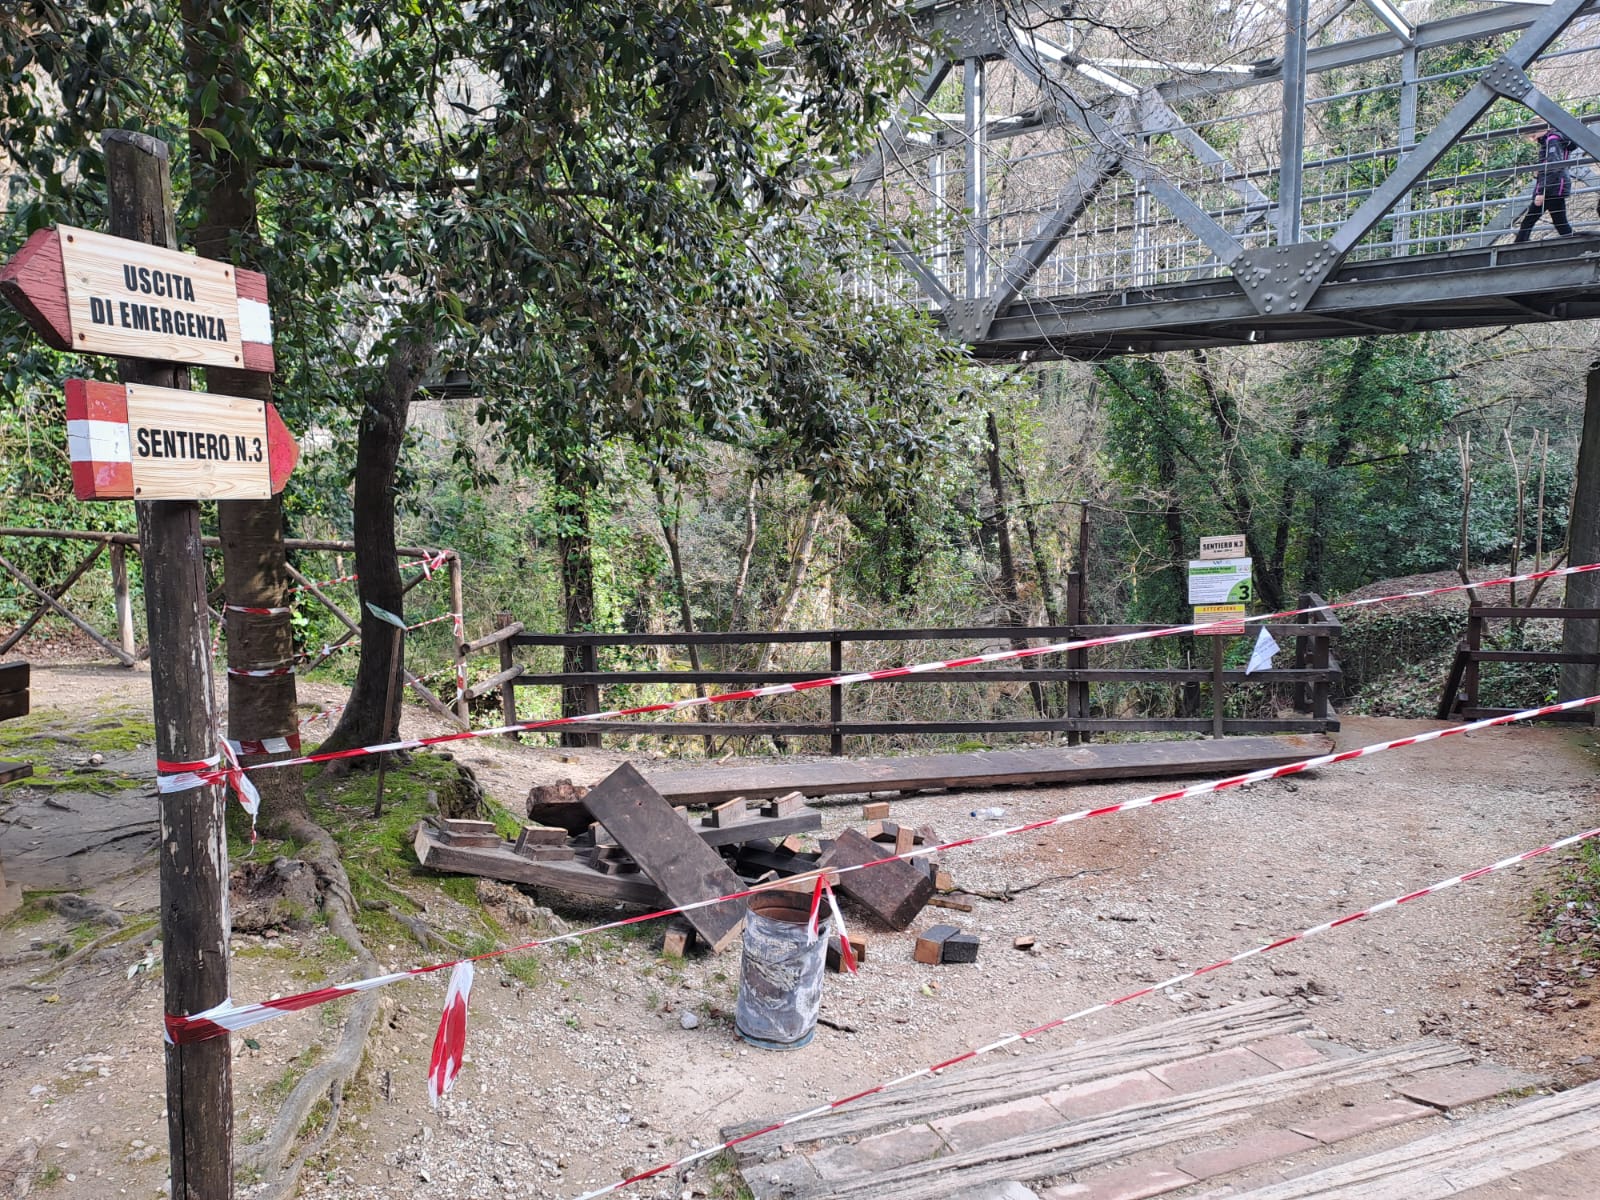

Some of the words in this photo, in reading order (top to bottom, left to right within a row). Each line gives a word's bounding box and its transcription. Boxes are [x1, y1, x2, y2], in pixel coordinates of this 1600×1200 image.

[123, 264, 195, 302] USCITA
[90, 297, 114, 326] DI
[119, 302, 228, 342] EMERGENZA
[137, 427, 230, 460] SENTIERO
[235, 436, 263, 463] N.3
[1202, 541, 1233, 551] SENTIERO
[1239, 585, 1250, 601] 3
